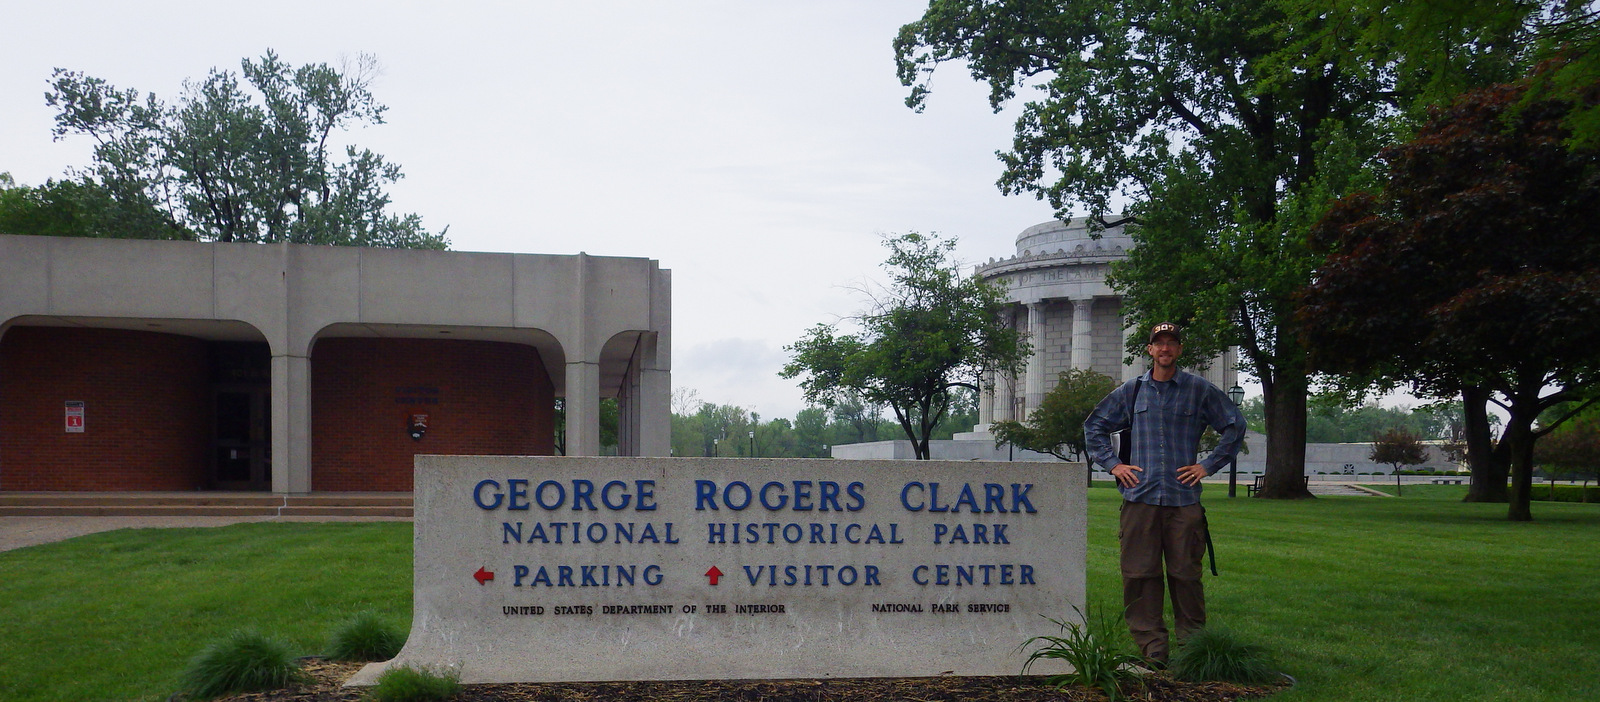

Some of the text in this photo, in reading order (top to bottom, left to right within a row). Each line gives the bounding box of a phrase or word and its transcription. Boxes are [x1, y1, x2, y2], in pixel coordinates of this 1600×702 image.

[1022, 272, 1036, 283] OF
[1042, 270, 1064, 282] THE
[472, 478, 1038, 513] GEORGE ROGERS CLARK
[502, 521, 1010, 545] NATIONAL HISTORICAL PARK
[513, 564, 1036, 587] PARKING VISITOR CENTER
[502, 604, 786, 616] UNITED STATES DEPARTMENT OF THE INTERIOR
[871, 603, 1011, 614] NATIONAL PARK SERVICE
